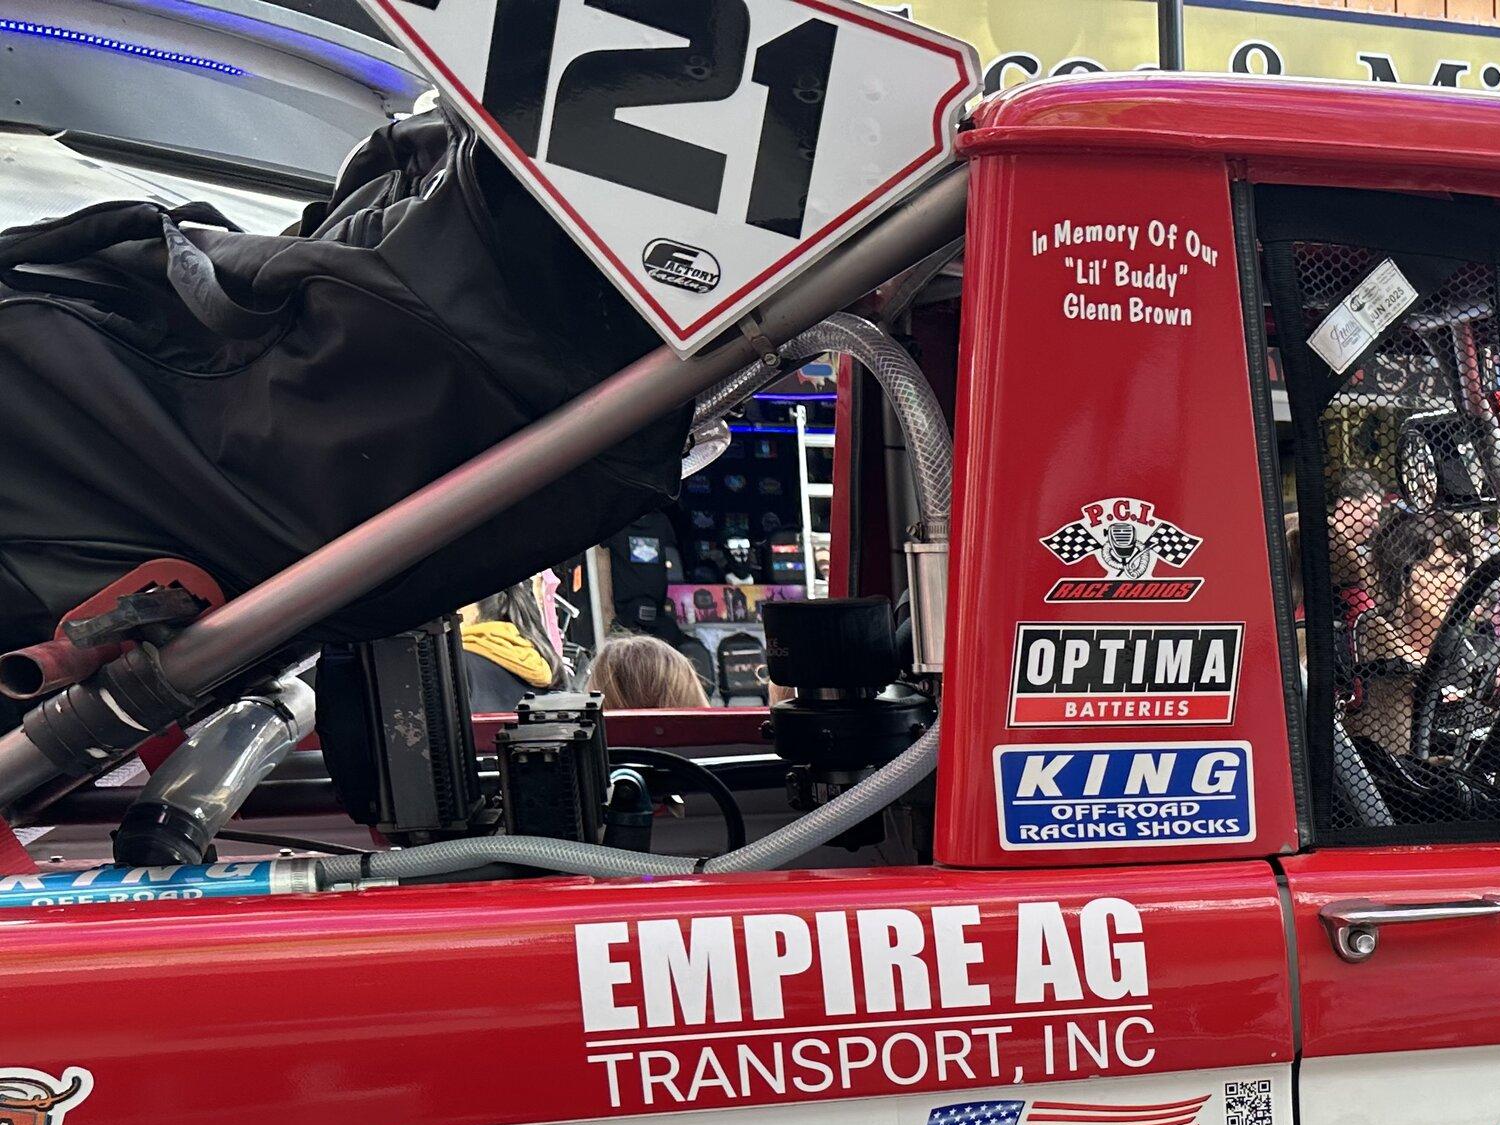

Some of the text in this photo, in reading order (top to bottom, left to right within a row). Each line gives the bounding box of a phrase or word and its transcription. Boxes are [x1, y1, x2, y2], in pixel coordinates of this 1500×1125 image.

[1032, 220, 1218, 267] In Memory Of Our
[1064, 293, 1192, 326] Glenn Brown
[1084, 500, 1156, 527] P.C.I.
[1053, 582, 1194, 598] RACE RADIOS
[1026, 638, 1226, 686] OPTIMA
[1064, 700, 1190, 718] BATTERIES
[1016, 751, 1241, 797] KING
[1051, 802, 1200, 821] OFF-ROAD
[1019, 819, 1240, 841] RACING SHOCKS
[574, 897, 1149, 1034] EMPIRE AG
[587, 1015, 1156, 1108] TRANSPORT, INC
